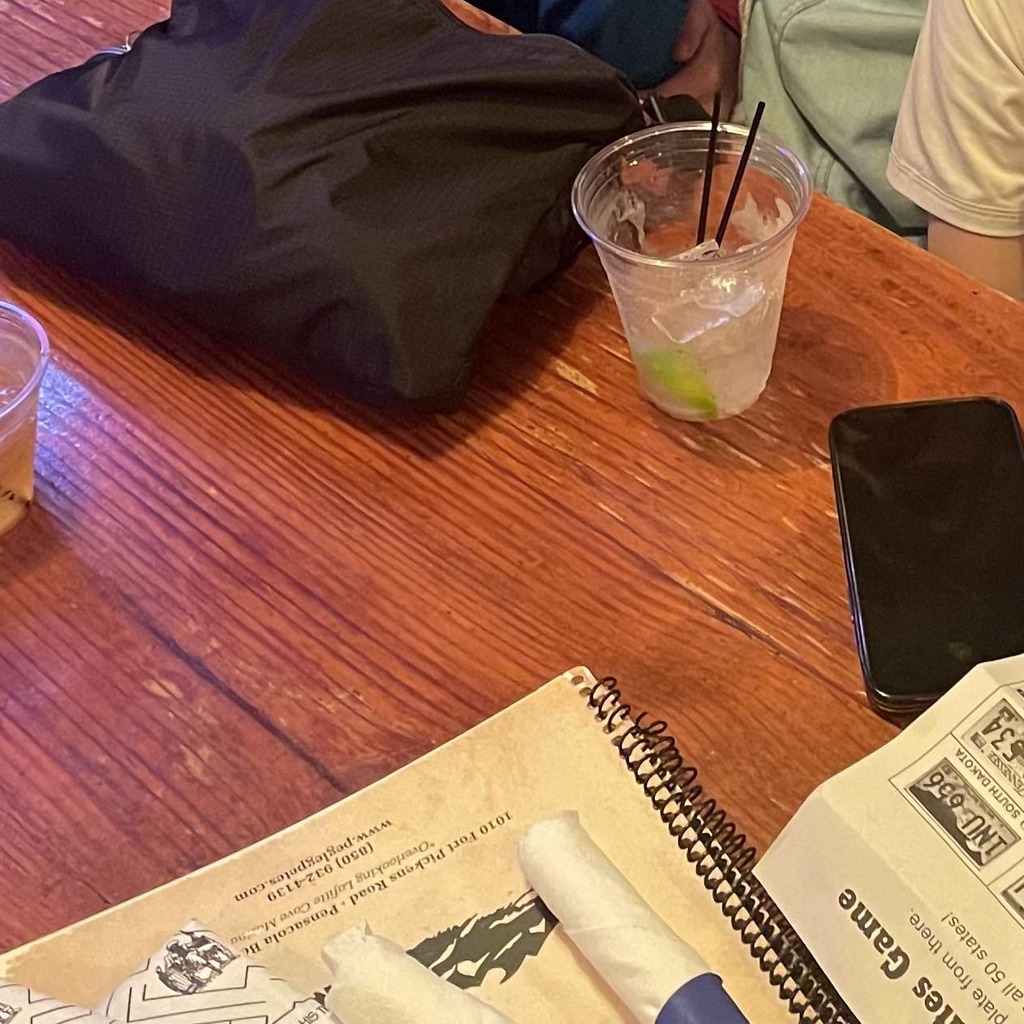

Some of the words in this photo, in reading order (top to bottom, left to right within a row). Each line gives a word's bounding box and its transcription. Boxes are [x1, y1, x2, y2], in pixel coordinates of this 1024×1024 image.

[953, 747, 992, 786] DAKOTA
[986, 782, 1021, 818] SOUTH
[477, 810, 511, 835] 1010
[333, 841, 374, 869] (850)
[446, 830, 477, 853] Fort
[233, 817, 392, 906] www.peglegpetes.com
[387, 847, 446, 885] Pickens
[265, 862, 333, 902] 932-4139
[311, 877, 355, 907] Lafitte
[348, 878, 387, 905] Road
[262, 903, 339, 948] Pensacola
[278, 900, 311, 923] Cove
[834, 887, 911, 981] Game
[906, 907, 943, 954] there.
[939, 910, 988, 960] states!
[940, 951, 972, 990] from
[982, 960, 1006, 984] 50
[970, 987, 1009, 1024] plate
[1001, 981, 1024, 1003] all
